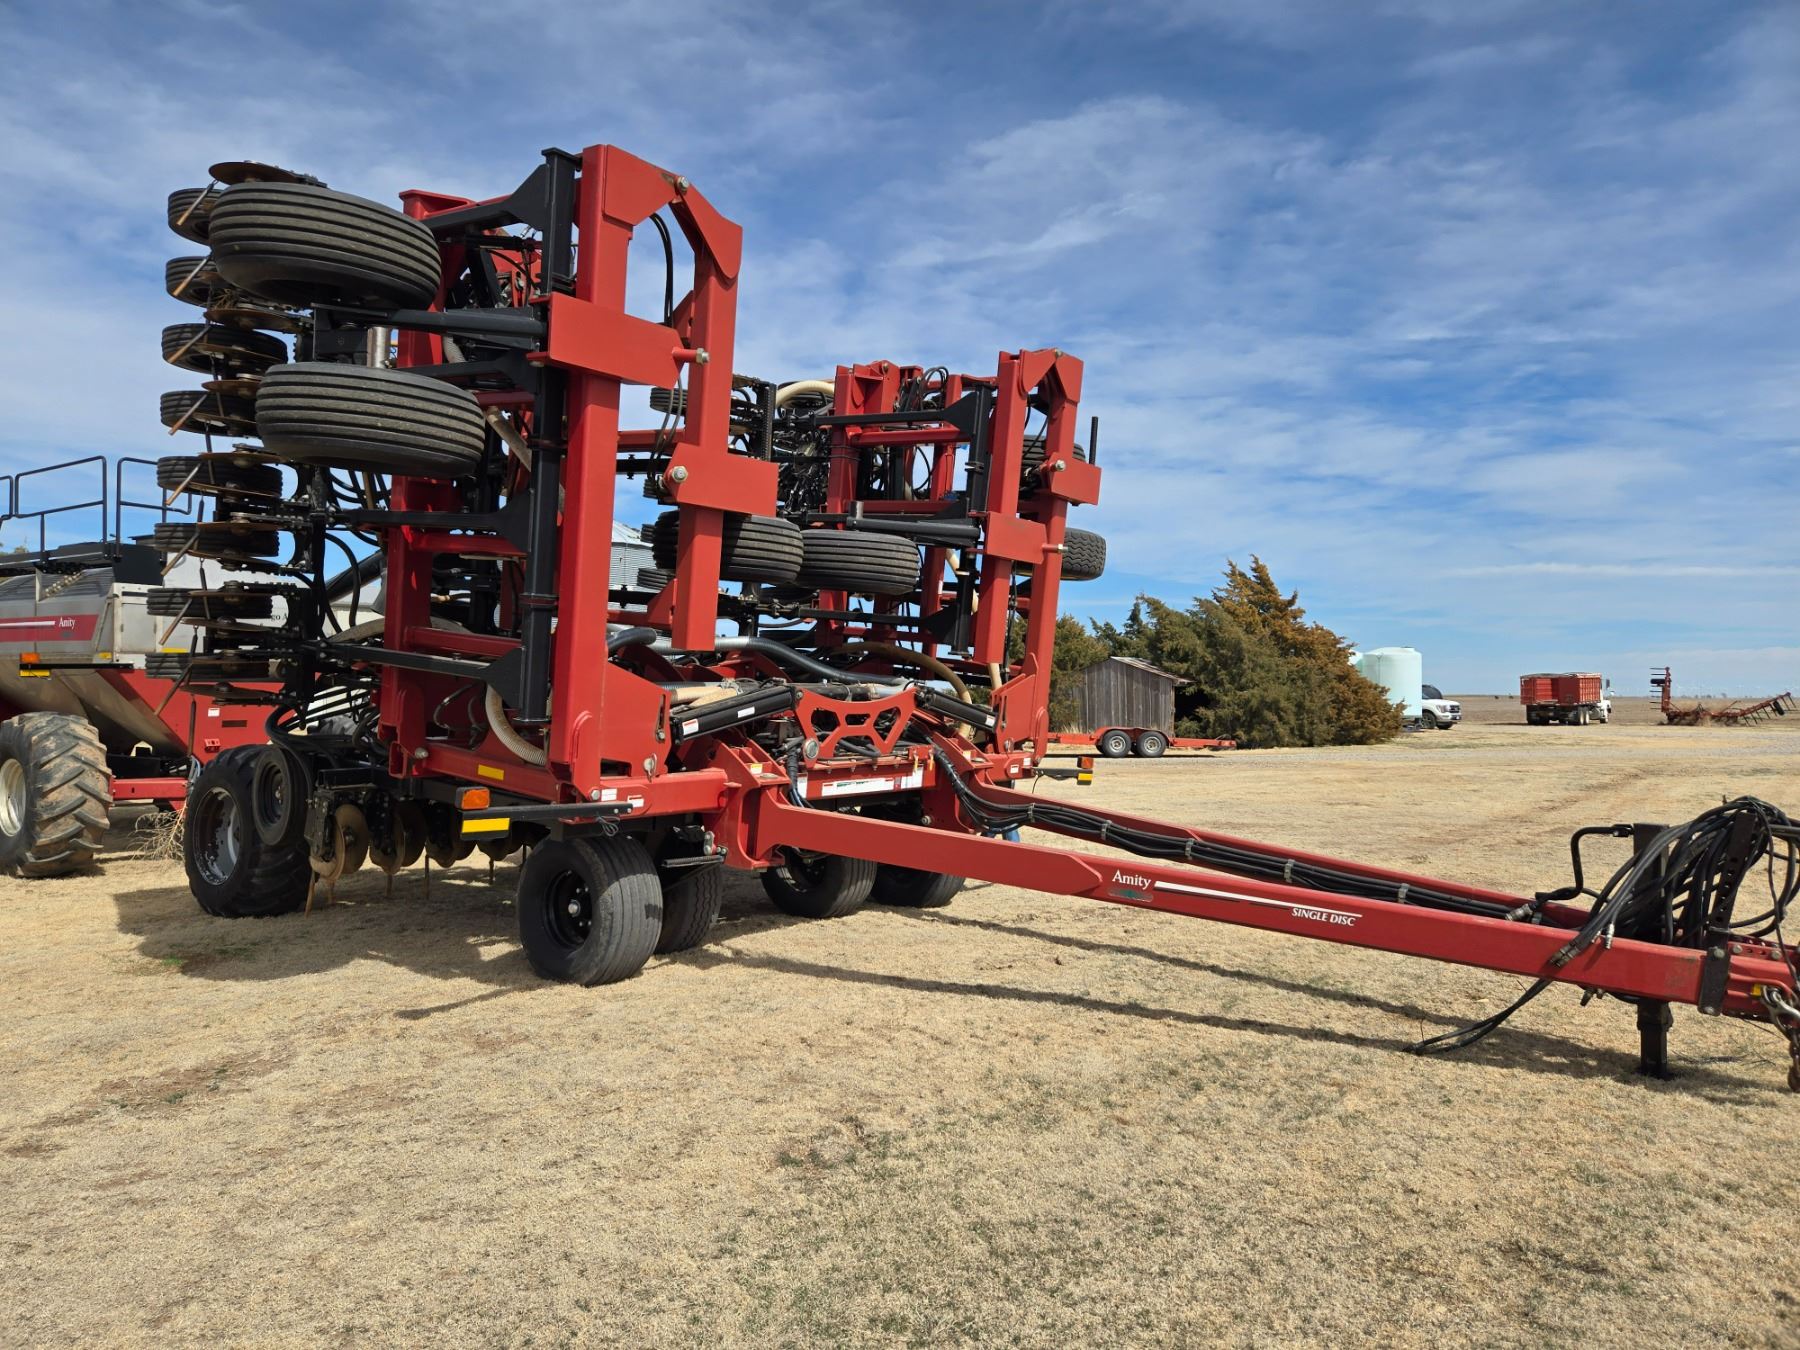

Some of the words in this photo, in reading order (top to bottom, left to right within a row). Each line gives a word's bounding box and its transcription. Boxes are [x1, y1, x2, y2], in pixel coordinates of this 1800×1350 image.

[59, 617, 76, 629] Amity
[1112, 869, 1151, 890] Amity
[1292, 907, 1328, 921] SINGLE
[1330, 914, 1356, 926] DISC
